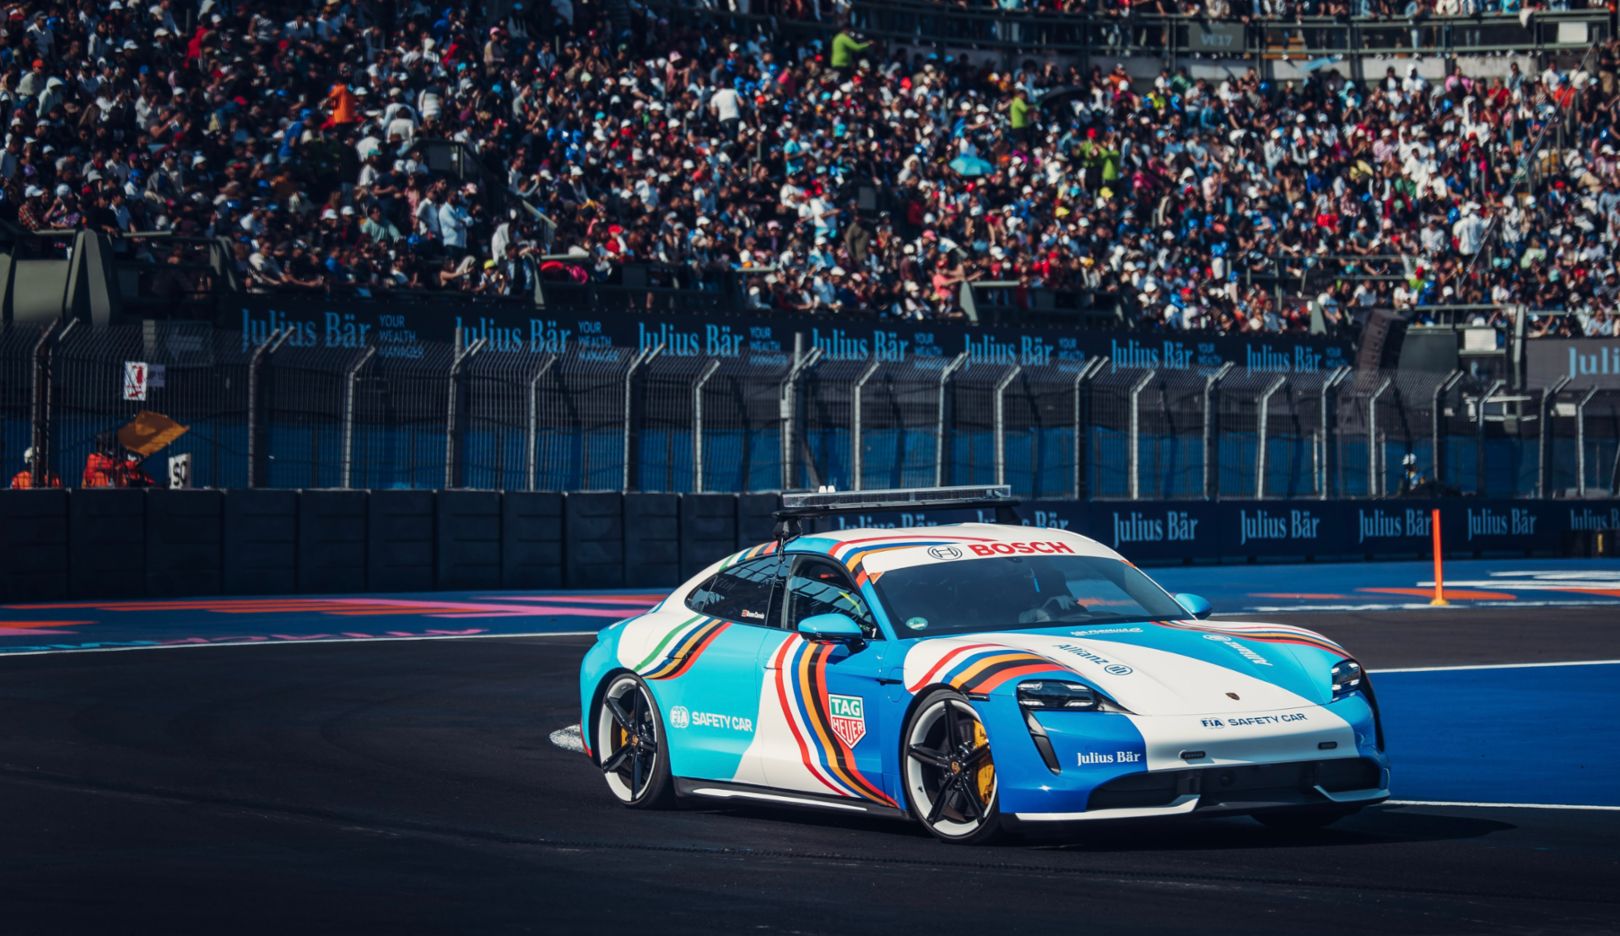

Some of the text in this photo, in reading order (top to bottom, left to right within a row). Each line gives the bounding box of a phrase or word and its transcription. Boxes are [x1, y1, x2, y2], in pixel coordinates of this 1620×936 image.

[242, 308, 372, 352] Julius Bär
[378, 313, 406, 328] YOUR
[378, 328, 417, 342] WEALTH
[530, 318, 572, 354] Bär
[577, 320, 602, 334] YOUR
[638, 322, 744, 358] Julius Bär
[812, 327, 909, 363] Julius Bär
[964, 333, 1054, 372] Julius Bär
[1111, 339, 1193, 374] Julius Bär
[1246, 343, 1290, 376] Julius
[1294, 345, 1322, 371] Bär
[1113, 510, 1199, 549] Julius Bär
[1240, 509, 1320, 546] Julius Bär
[1359, 508, 1432, 544] Julius Bär
[1467, 508, 1537, 542] Julius Bär
[967, 541, 1076, 557] BOSCH
[1053, 643, 1109, 665] Allianz
[691, 711, 731, 729] SAFETY
[732, 716, 754, 733] CAR
[831, 698, 861, 717] TAG
[1200, 712, 1308, 728] FIA SAFETY CAR
[832, 718, 864, 744] HEUER
[1076, 750, 1142, 767] Julius Bär
